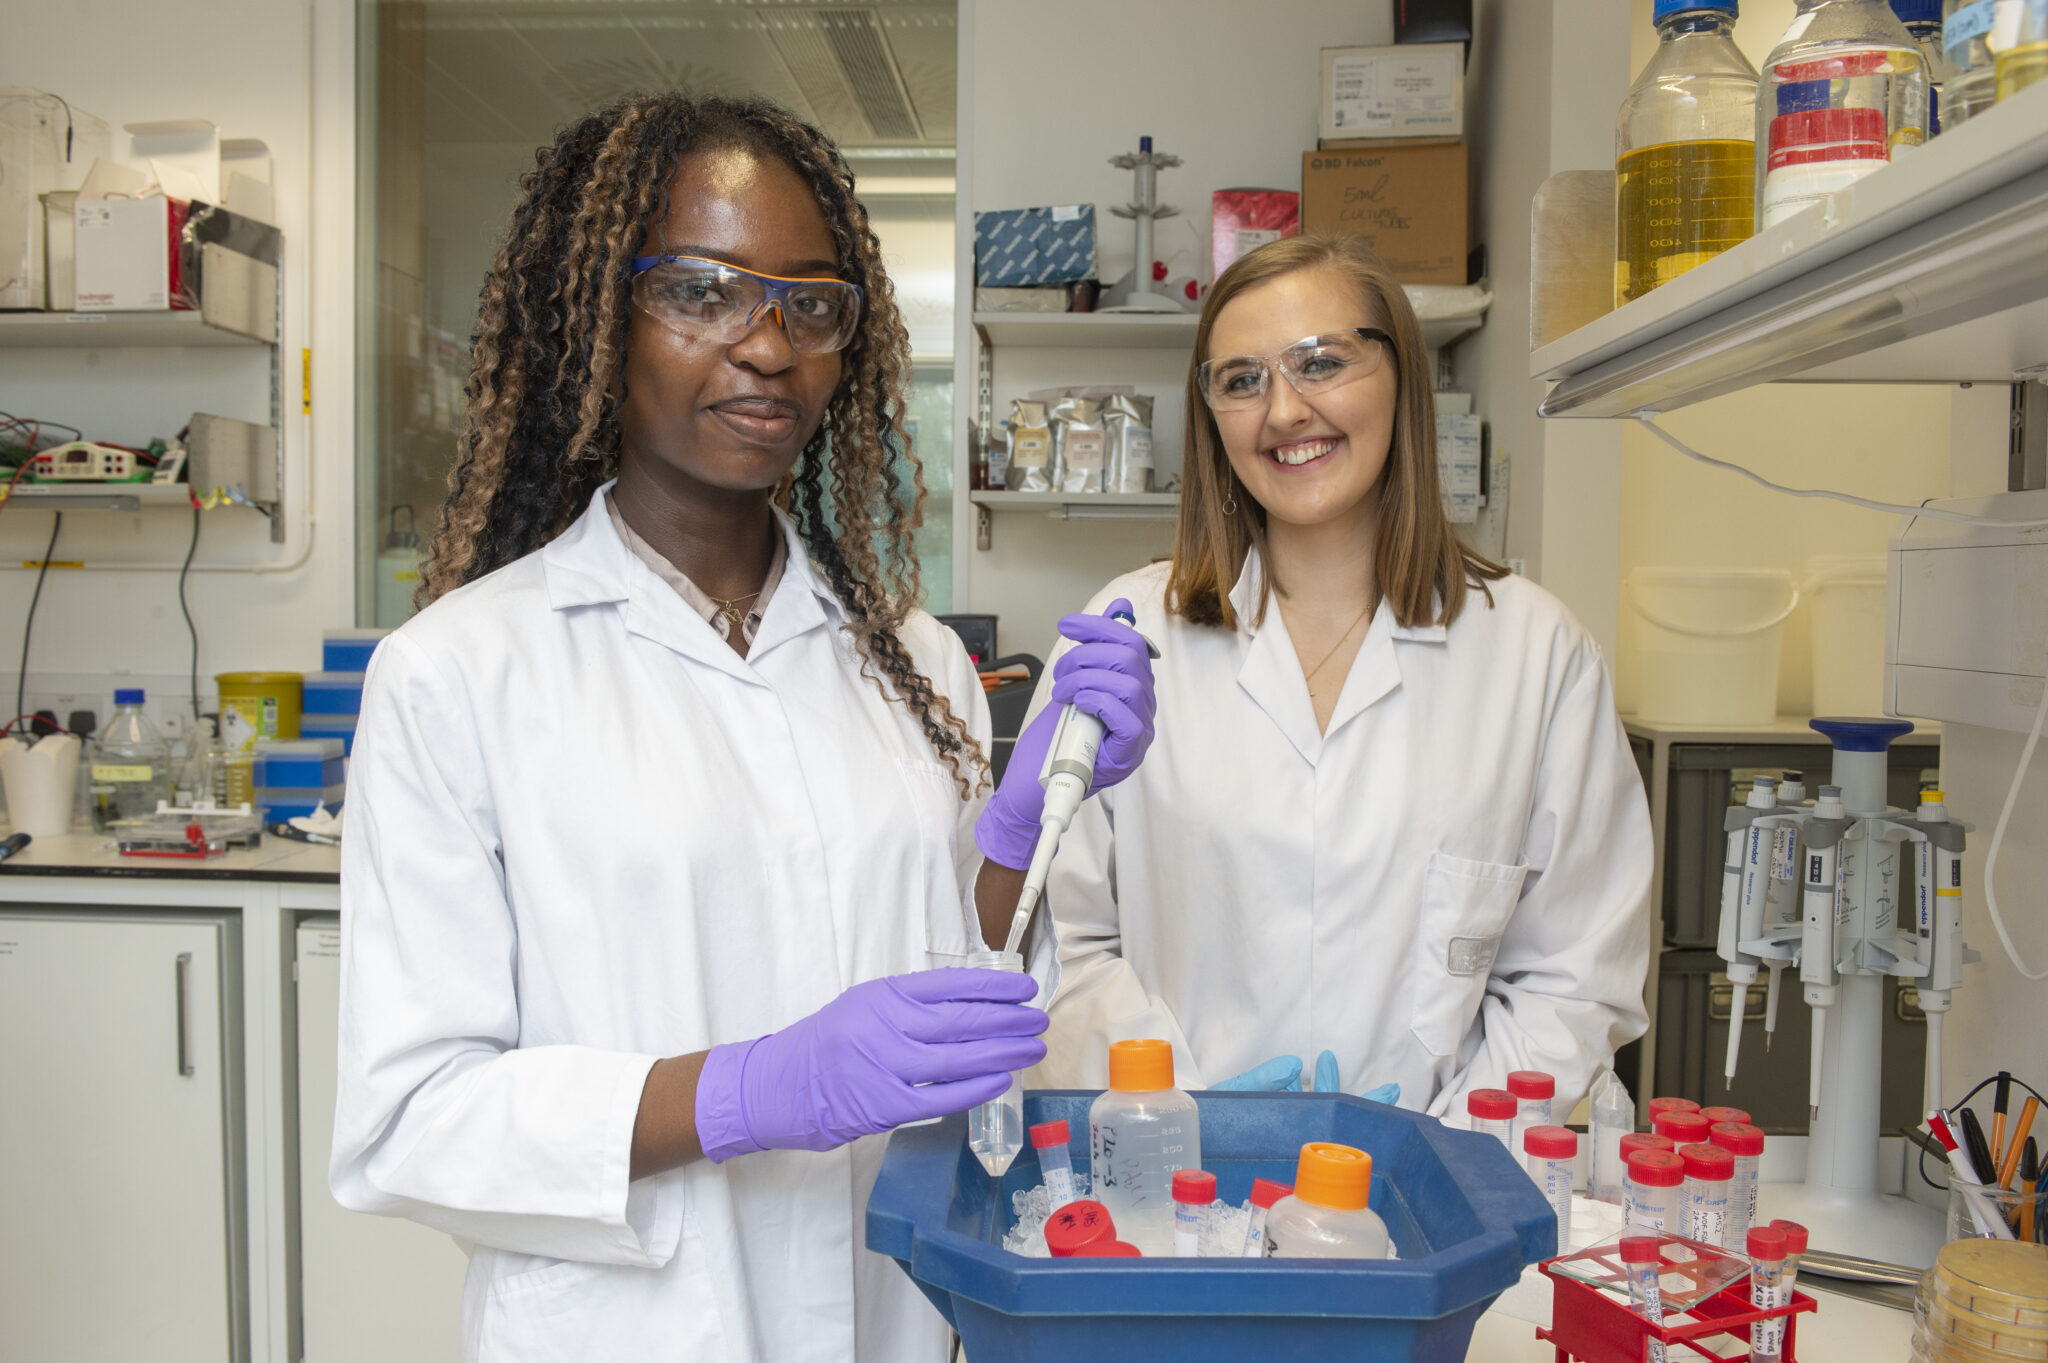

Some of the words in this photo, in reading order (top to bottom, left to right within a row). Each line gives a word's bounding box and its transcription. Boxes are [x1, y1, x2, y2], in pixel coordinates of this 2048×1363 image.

[1325, 158, 1342, 169] BD
[1346, 157, 1382, 168] Falcon
[1751, 827, 1760, 866] eppendorf
